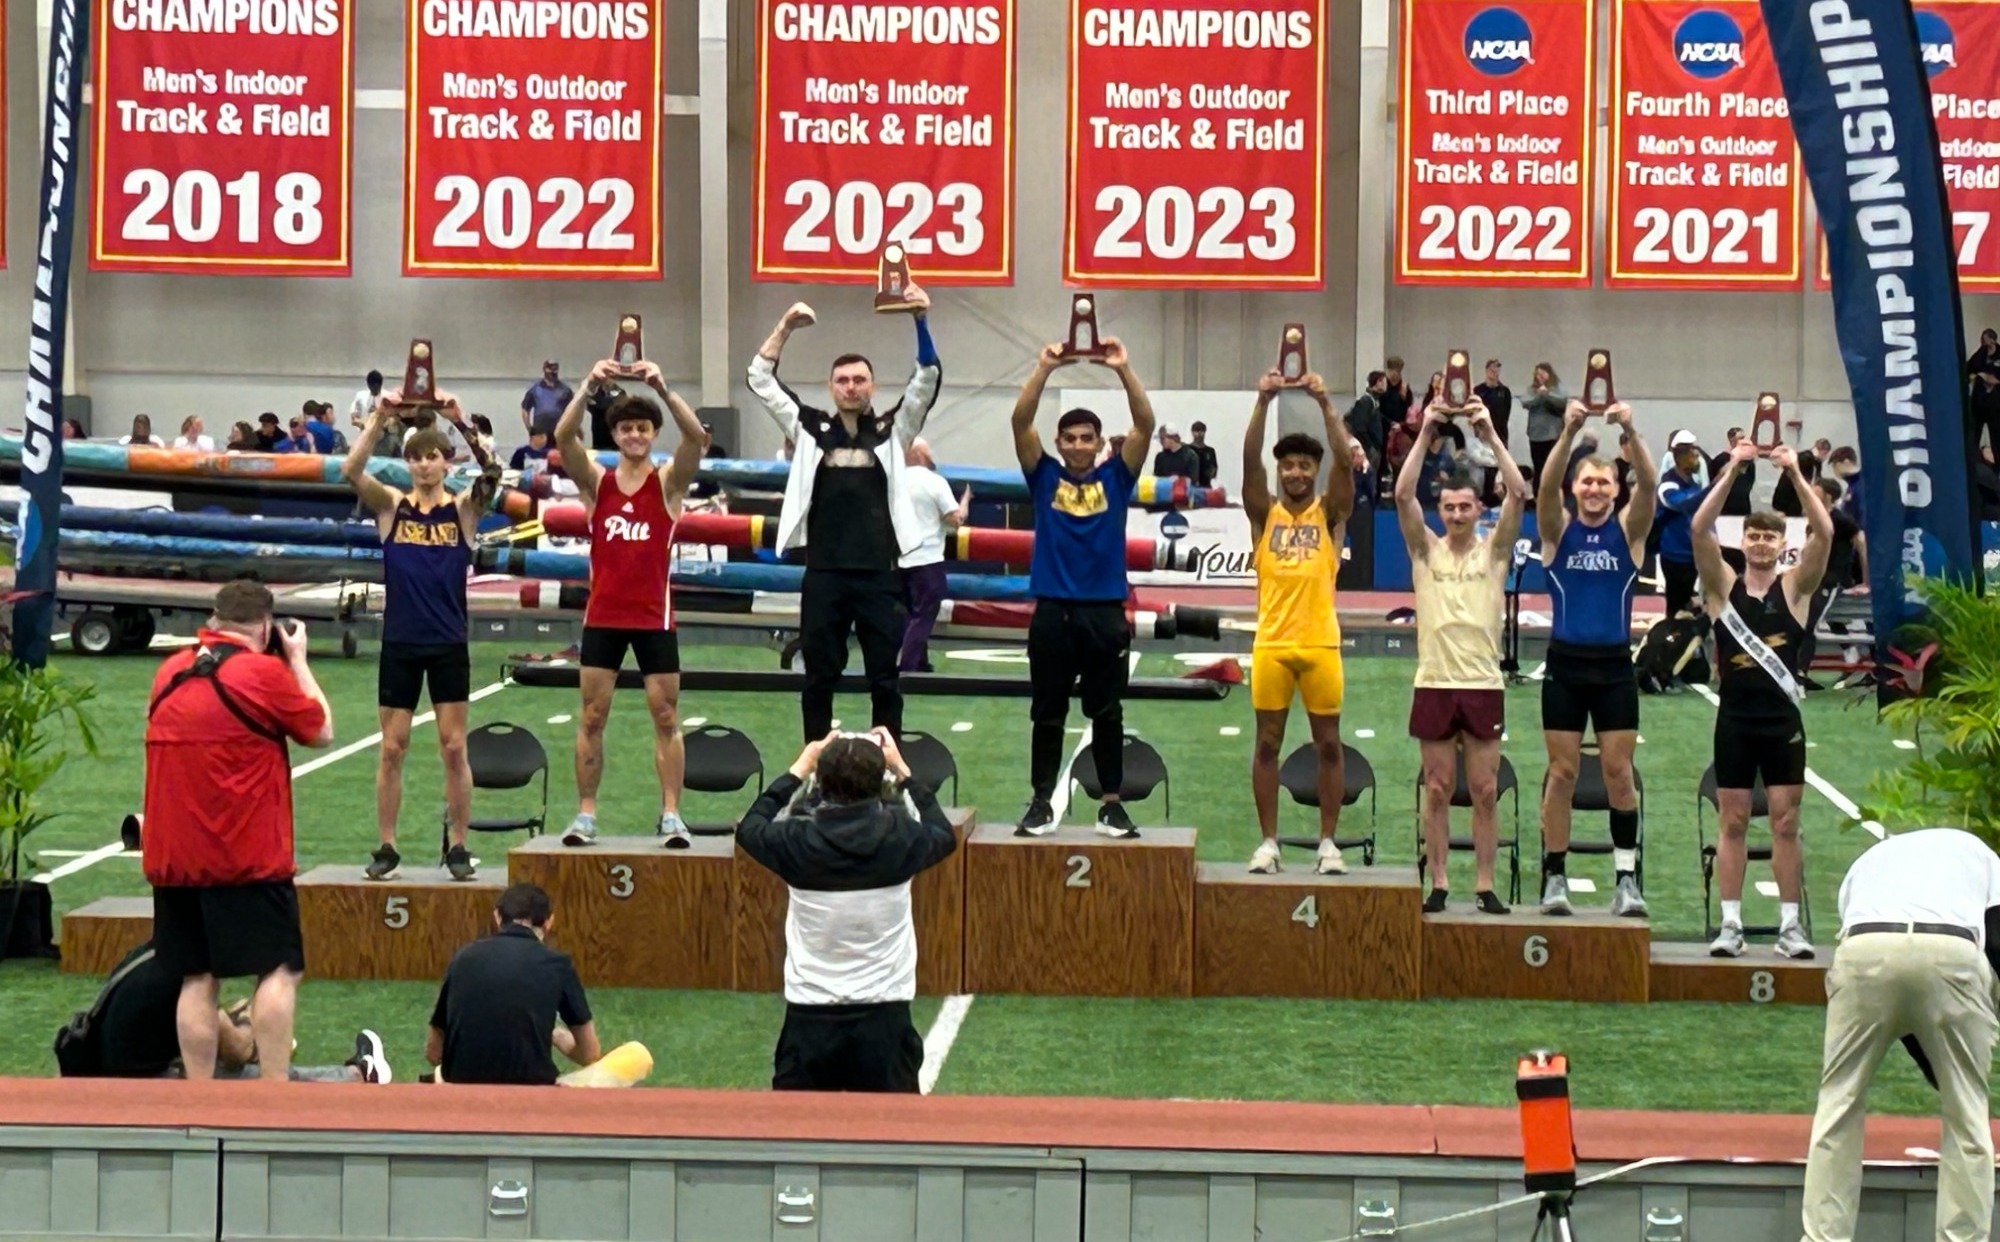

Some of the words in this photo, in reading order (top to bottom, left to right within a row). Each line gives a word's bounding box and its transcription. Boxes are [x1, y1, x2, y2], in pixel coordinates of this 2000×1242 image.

[112, 0, 339, 36] CHAMPIONS
[423, 0, 649, 40] CHAMPIONS
[774, 2, 1000, 45] CHAMPIONS
[1084, 8, 1312, 49] CHAMPIONS
[1469, 40, 1530, 60] NCAA
[1680, 42, 1740, 62] NCAA
[143, 66, 218, 93] Men's
[225, 69, 308, 96] Indoor
[443, 72, 518, 100] Men's
[526, 73, 627, 101] Outdoor
[805, 77, 879, 104] Men's
[887, 78, 969, 106] Indoor
[1105, 82, 1182, 109] Men's
[1189, 83, 1291, 110] Outdoor
[1425, 88, 1491, 115] Third
[1499, 89, 1569, 116] Place
[1626, 91, 1711, 117] Fourth
[1719, 92, 1790, 118] Place
[1931, 93, 2000, 119] Place
[116, 100, 208, 134] Track
[216, 102, 243, 135] &
[252, 103, 330, 137] Field
[428, 106, 520, 140] Track
[528, 108, 555, 140] &
[565, 109, 642, 142] Field
[779, 111, 870, 145] Track
[879, 113, 905, 145] &
[915, 113, 992, 147] Field
[1089, 116, 1181, 150] Track
[1190, 117, 1217, 150] &
[1226, 118, 1304, 151] Field
[1432, 131, 1492, 153] Men's
[1496, 133, 1562, 154] Indoor
[1637, 134, 1696, 156] Men's
[1699, 135, 1778, 157] Outdoor
[1413, 158, 1483, 184] Track
[1489, 159, 1511, 184] &
[1517, 159, 1578, 185] Field
[1625, 160, 1696, 186] Track
[1701, 162, 1722, 187] &
[1729, 162, 1788, 187] Field
[1942, 163, 2000, 190] Field
[121, 168, 323, 245] 2018
[432, 175, 635, 250] 2022
[783, 179, 984, 256] 2023
[1093, 185, 1296, 261] 2023
[1418, 204, 1572, 261] 2022
[1632, 207, 1778, 264] 2021
[611, 865, 635, 897] 3
[1066, 855, 1091, 887] 2
[385, 896, 409, 928] 5
[1292, 895, 1319, 928] 4
[1523, 935, 1548, 967] 6
[1750, 971, 1775, 1001] 8
